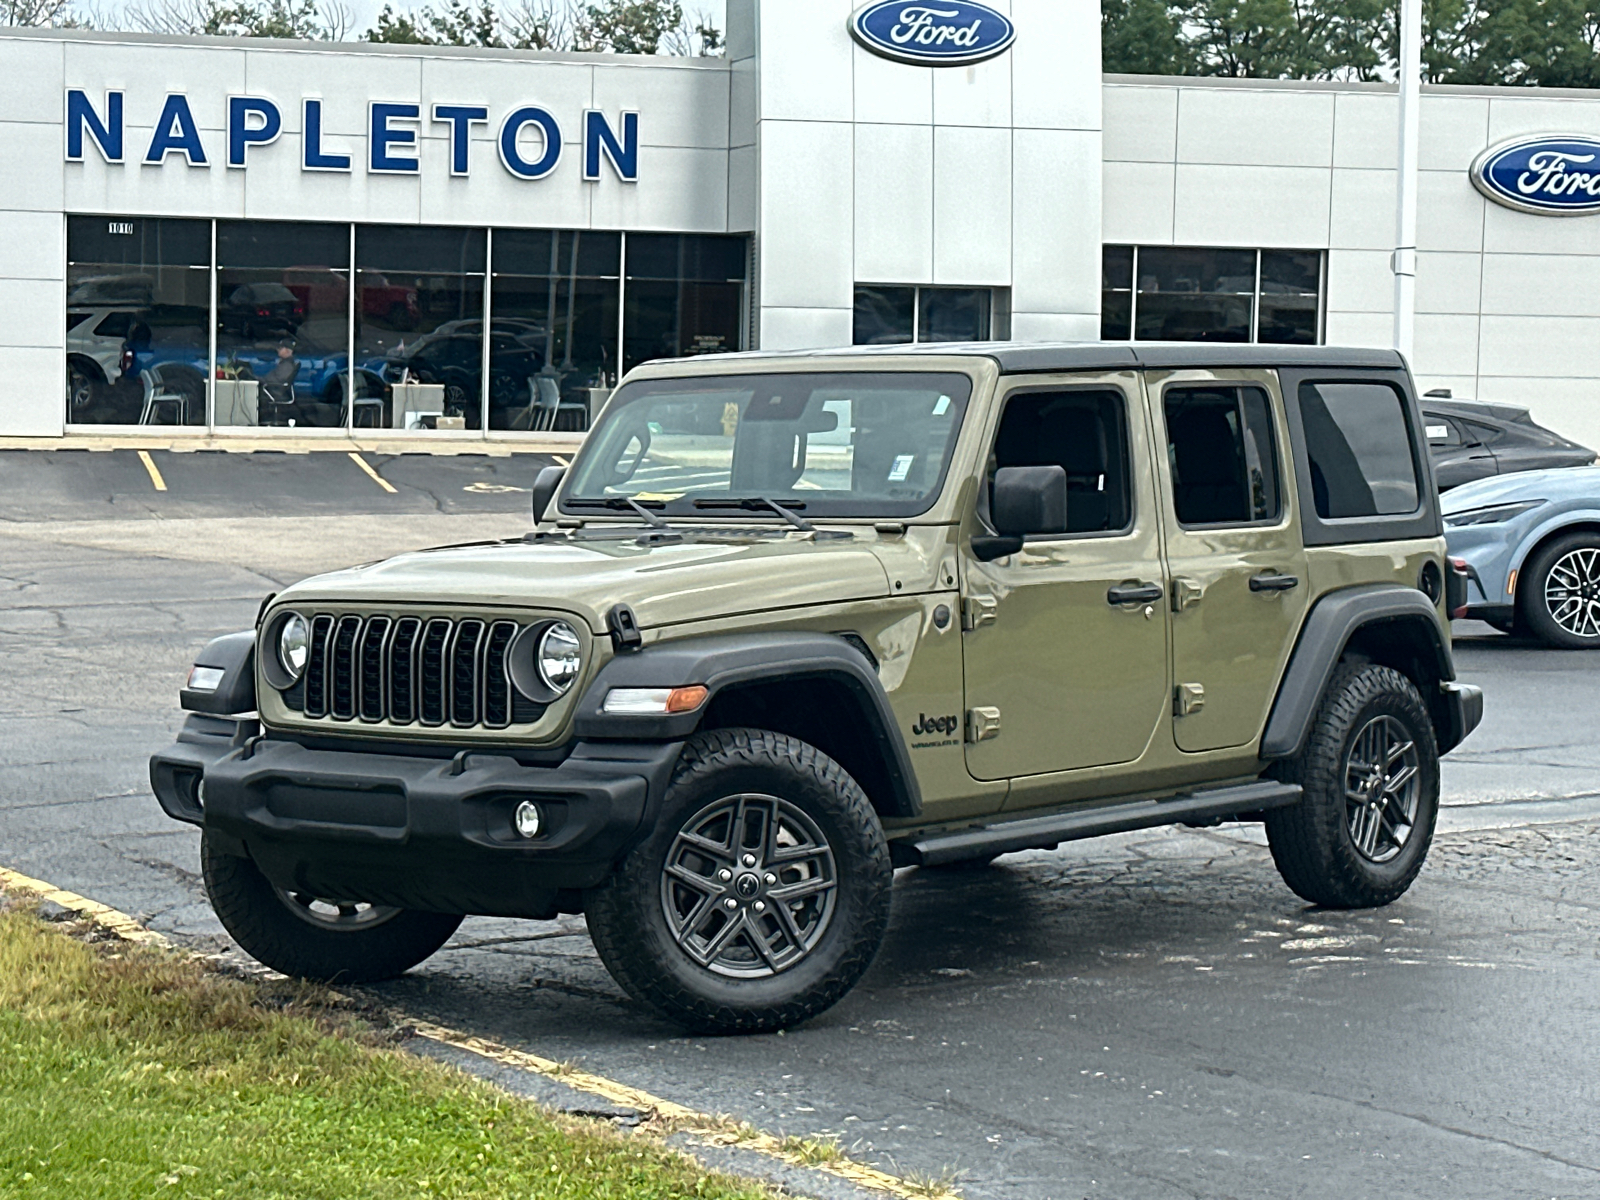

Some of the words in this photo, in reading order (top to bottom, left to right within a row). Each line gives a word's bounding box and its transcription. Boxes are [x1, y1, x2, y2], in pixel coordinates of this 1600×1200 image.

[890, 6, 982, 47] Ford
[64, 87, 641, 183] NAPLETON
[108, 222, 134, 235] 1010
[912, 712, 957, 736] Jeep
